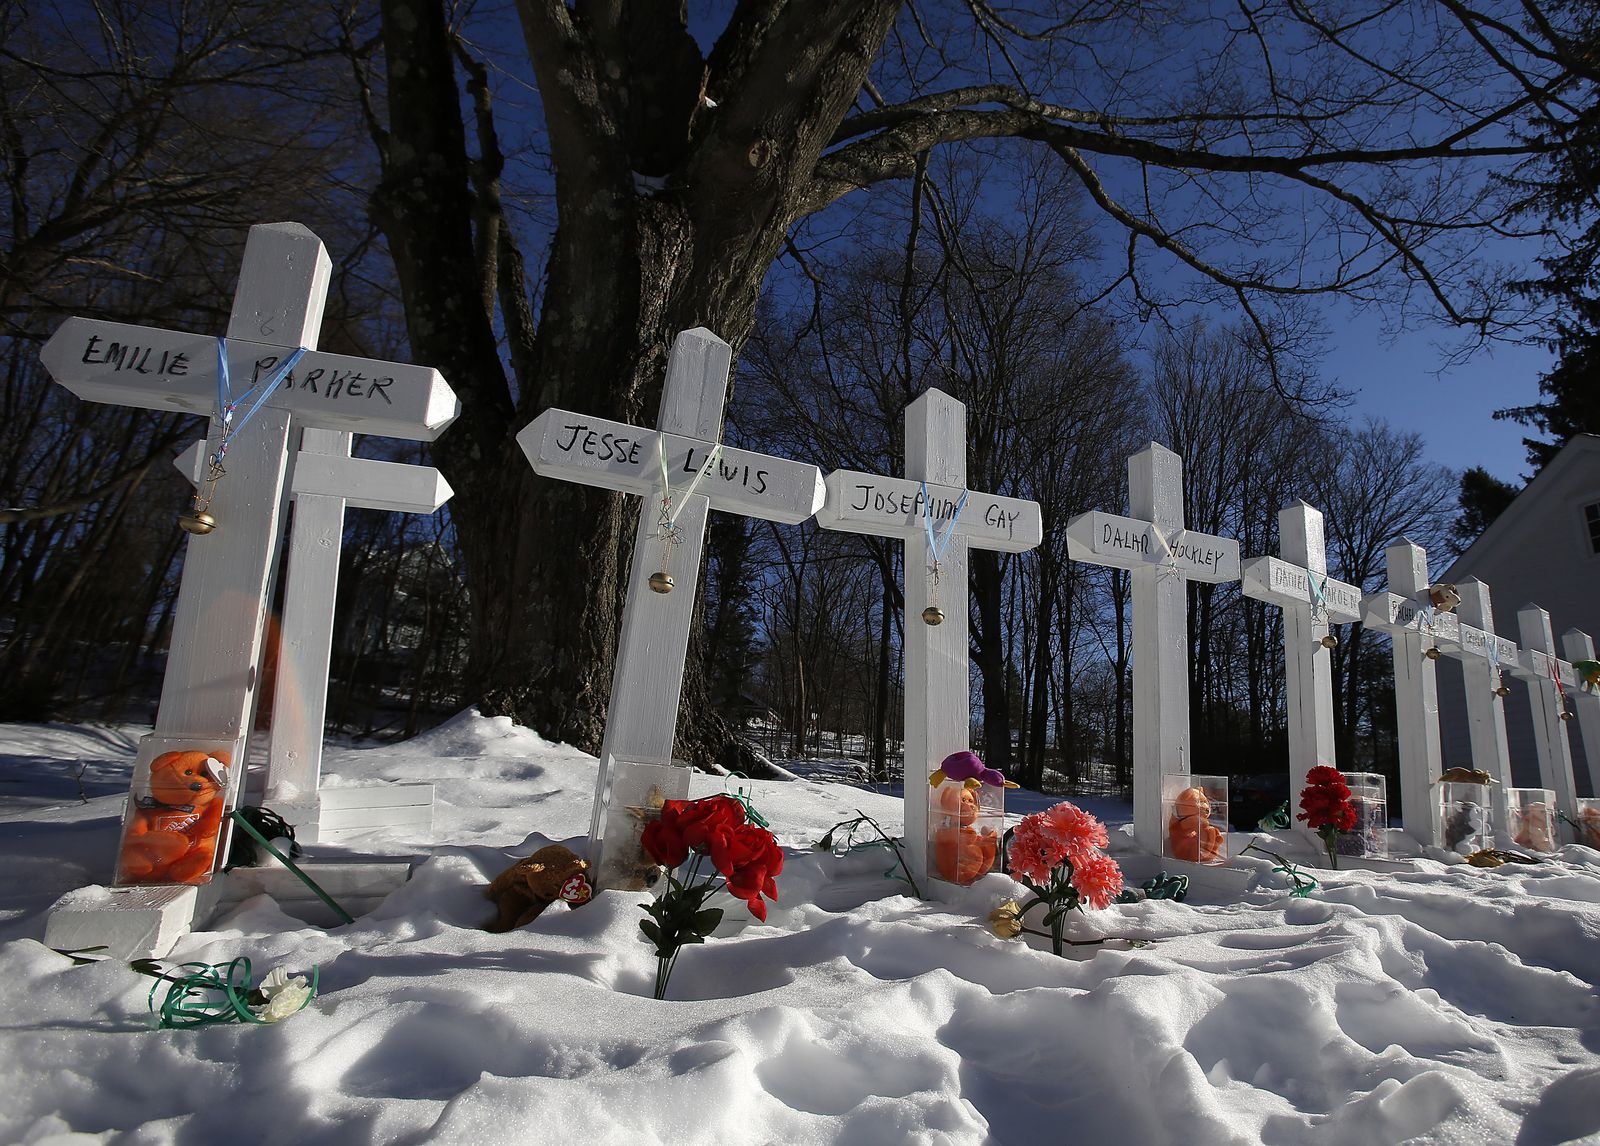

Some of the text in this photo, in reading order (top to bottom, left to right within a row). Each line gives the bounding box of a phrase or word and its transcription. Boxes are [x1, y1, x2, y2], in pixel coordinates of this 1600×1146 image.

[82, 335, 396, 405] EMILIE PARKER
[557, 424, 769, 495] JESSE LEWIS
[985, 503, 1020, 541] GAY
[1167, 540, 1224, 575] HOCKLEY
